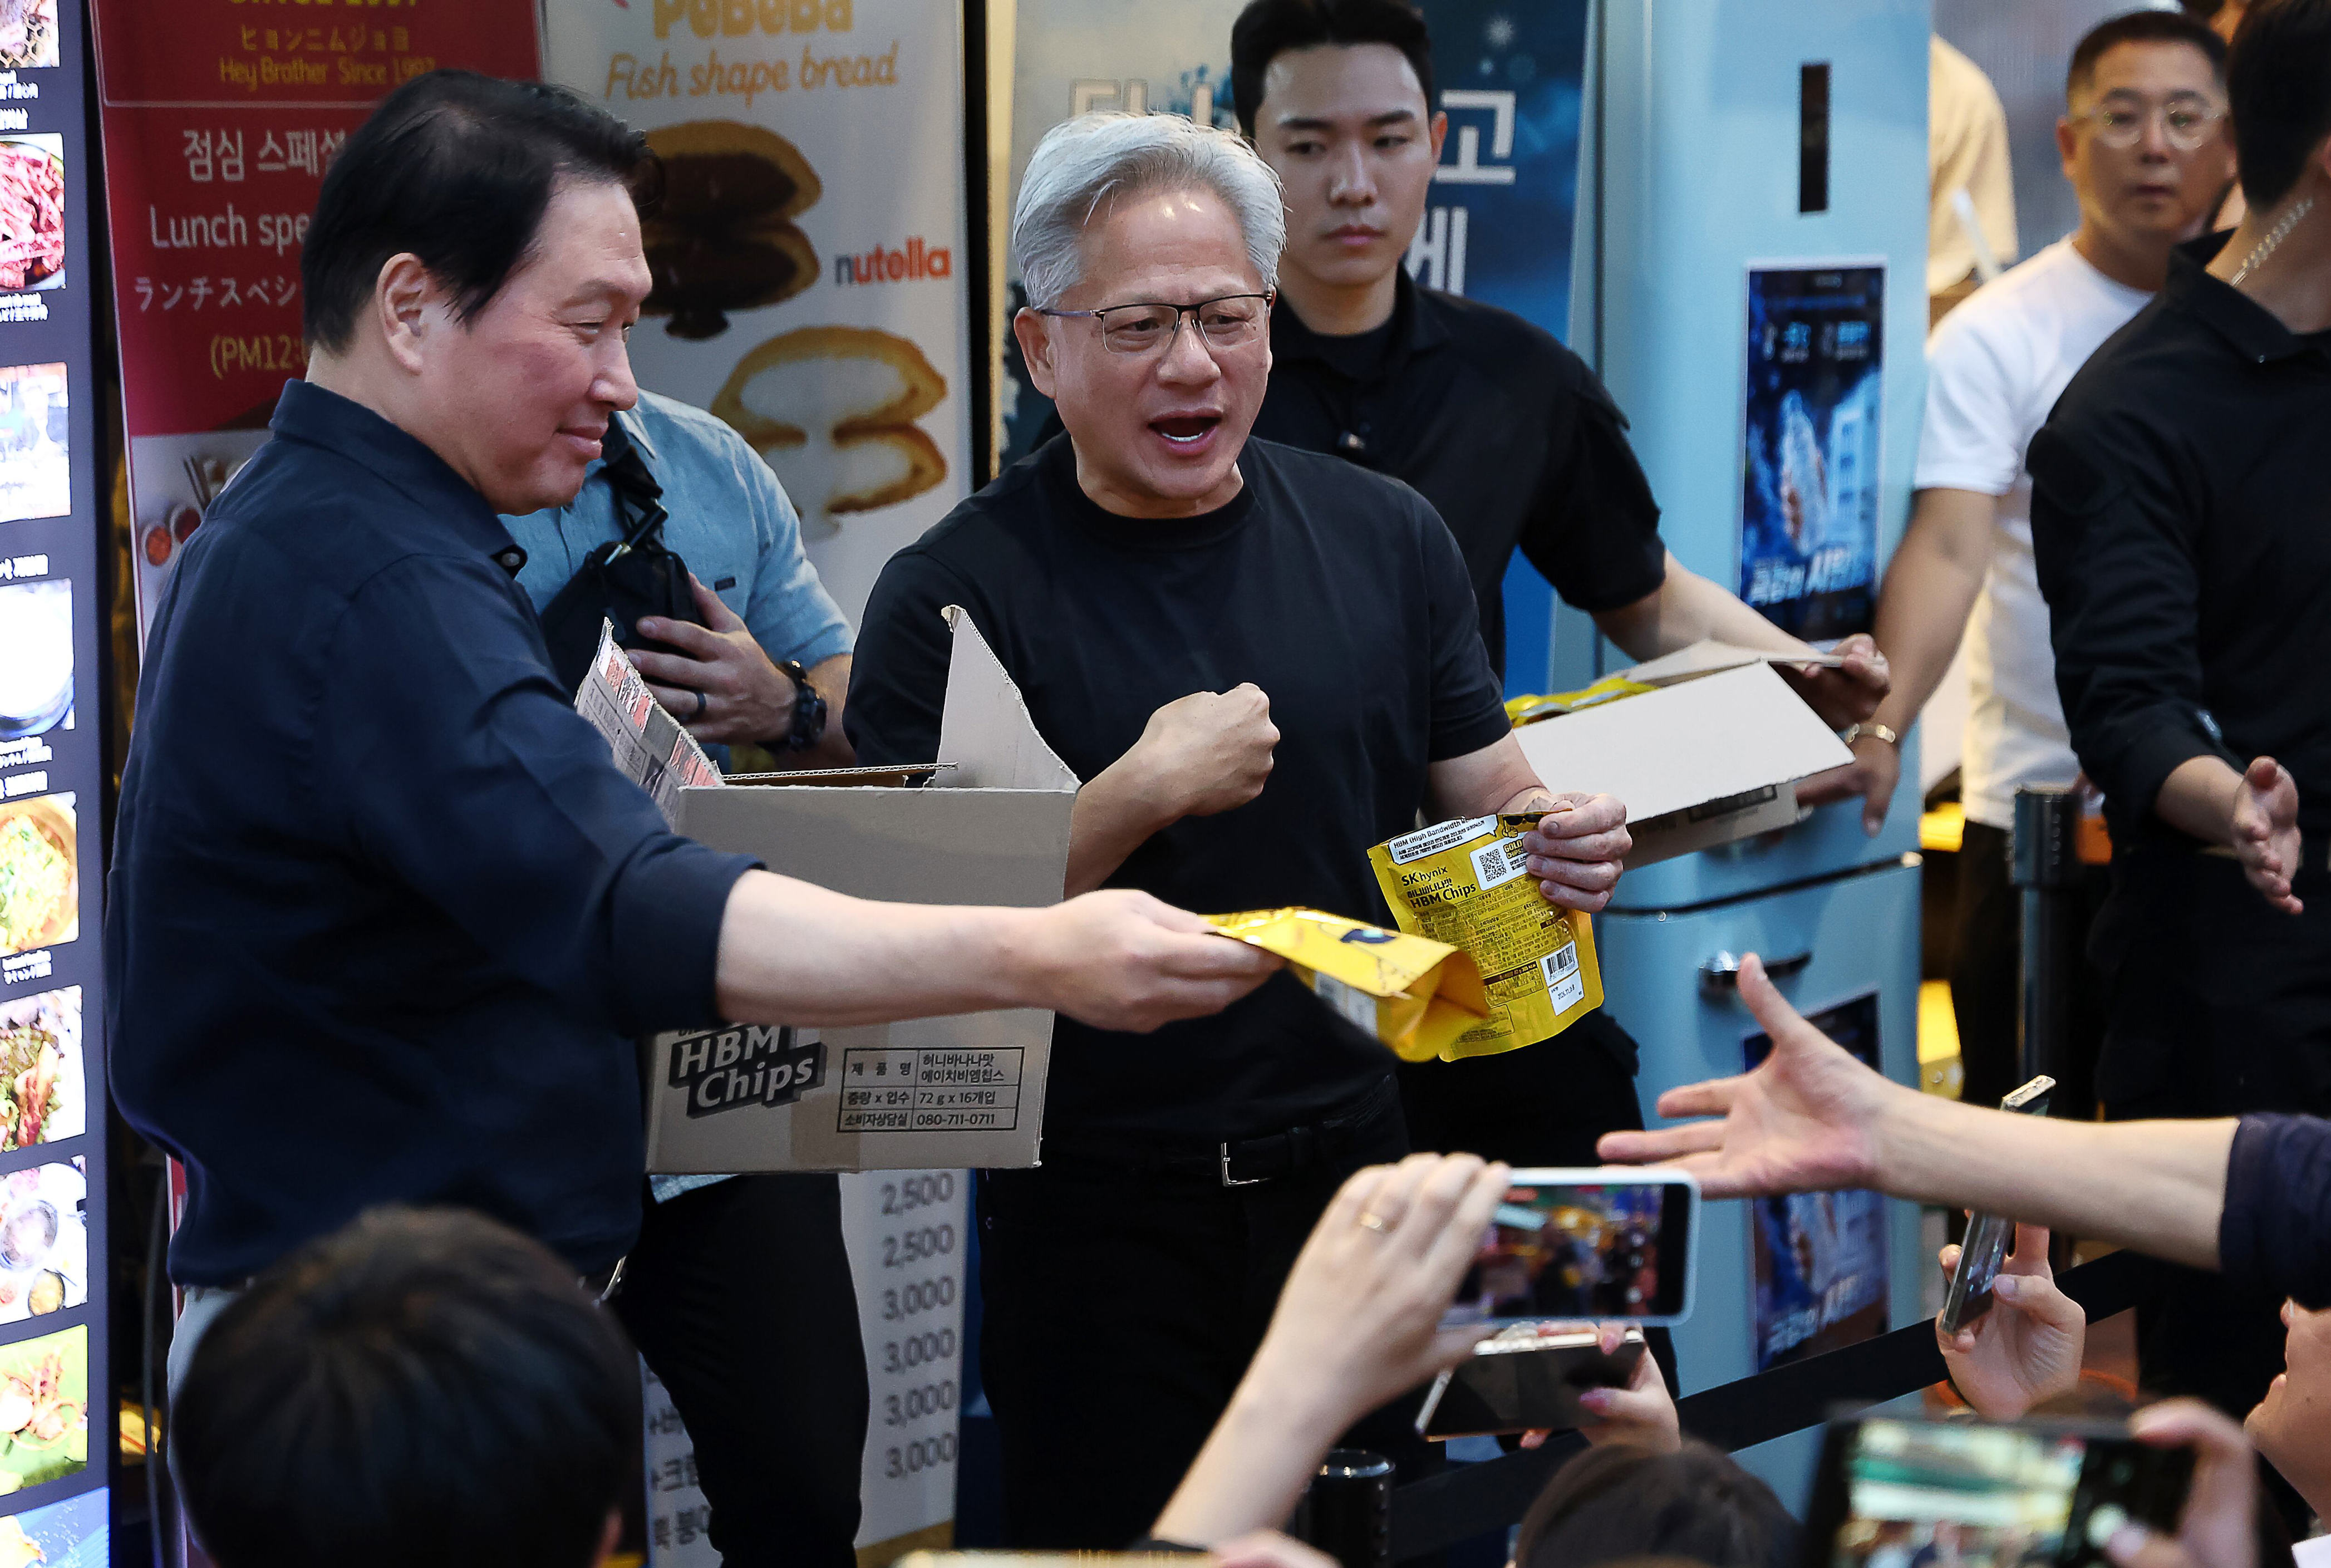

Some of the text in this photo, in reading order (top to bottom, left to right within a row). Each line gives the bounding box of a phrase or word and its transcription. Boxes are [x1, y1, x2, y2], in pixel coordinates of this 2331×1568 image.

[220, 56, 258, 92] Hey
[260, 56, 328, 85] Brother
[605, 40, 898, 109] Fish shape bread
[183, 129, 244, 182] 점심
[150, 202, 248, 249] Lunch
[835, 235, 951, 287] nutella
[1394, 838, 1409, 849] HBM
[1504, 839, 1522, 853] GOLD
[1401, 867, 1448, 886] SK hynix
[1410, 883, 1476, 908] HBM Chips
[678, 1025, 781, 1078] HBM
[899, 1061, 911, 1076] 명
[923, 1054, 995, 1068] 허니바나나맛
[697, 1058, 814, 1108] Chips
[922, 1069, 1005, 1083] 에이치비엠칩스
[887, 1091, 910, 1105] 입수
[919, 1093, 932, 1104] 72
[960, 1091, 996, 1105] 16개입
[844, 1113, 908, 1127] 소비자상담실
[917, 1114, 995, 1125] 080-711-0711
[881, 1173, 954, 1216] 2,500
[882, 1225, 955, 1267] 2,500
[882, 1276, 955, 1321] 3,000
[884, 1329, 956, 1373] 3,000
[884, 1381, 956, 1426] 3,000
[886, 1433, 957, 1479] 3,000
